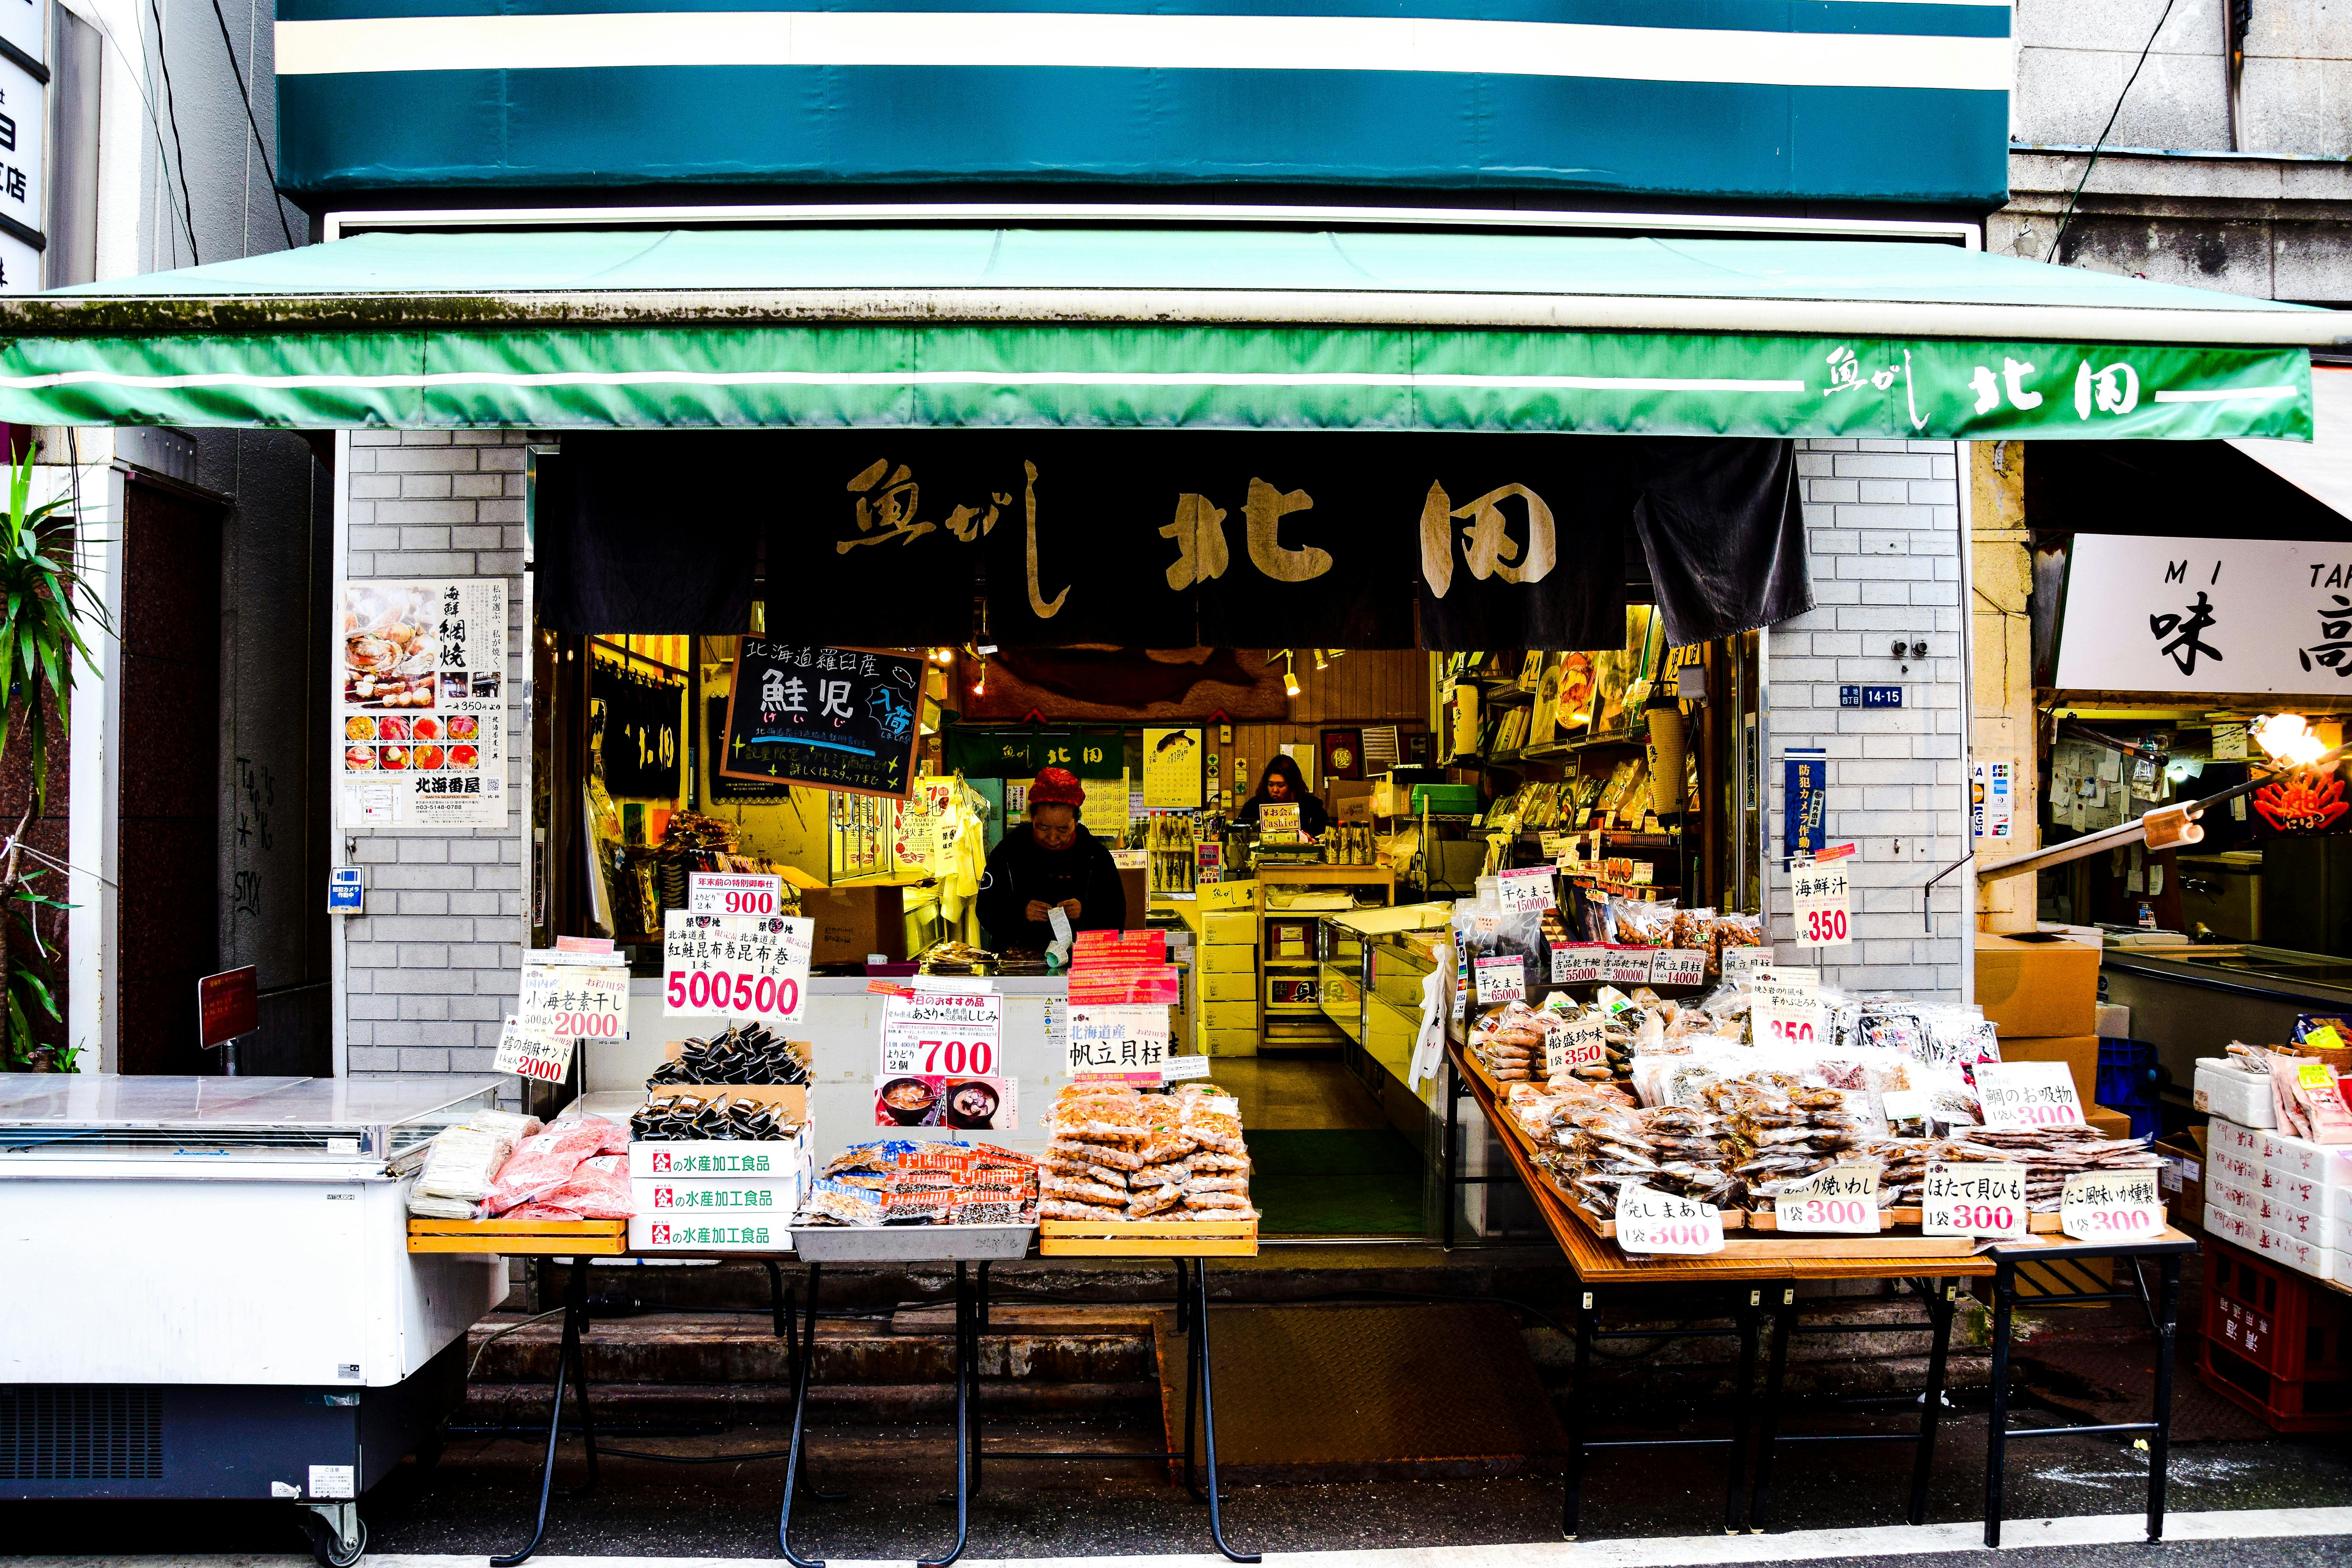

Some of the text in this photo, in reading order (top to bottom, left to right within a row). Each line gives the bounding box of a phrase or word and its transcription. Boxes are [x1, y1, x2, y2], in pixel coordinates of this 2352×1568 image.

[1824, 346, 2139, 429] 魚がし 北田
[836, 457, 1555, 618] 魚がし 北田
[439, 586, 466, 668] 海鮮網焼
[492, 584, 501, 669] 私が選ぶ、 私が焼く。
[2149, 591, 2223, 676] 味
[746, 641, 880, 677] 北海道羅臼産
[760, 668, 853, 718] 鮭児
[1868, 691, 1899, 702] 14-15
[872, 689, 913, 734] 入荷
[1047, 747, 1102, 764] 北田
[789, 763, 879, 785] 詳しくはスタッフまで
[416, 777, 481, 793] 北海番屋
[1263, 818, 1298, 828] Cashier
[698, 878, 774, 888] 年末前の特別御奉仕
[1795, 876, 1847, 897] 海鮮汁
[1503, 886, 1551, 901] 干なまこ
[668, 929, 707, 940] 北海道産
[740, 933, 810, 949] 北海道産 限定品
[1797, 929, 1809, 939] 1袋
[668, 941, 735, 959] 紅鮭昆布巻
[738, 944, 789, 965] 昆布巻
[691, 960, 712, 970] 1本
[759, 965, 780, 976] 1本
[1555, 958, 1601, 969] 吉品乾干鮑
[1604, 960, 1648, 969] 吉品乾干鮑
[1655, 960, 1702, 973] 帆立貝柱
[667, 971, 731, 1008] 500
[1479, 978, 1523, 990] 干なまこ
[1754, 985, 1804, 996] 焼き岩のり風味
[527, 990, 622, 1012] 小海老素干し
[906, 996, 984, 1007] 本日のおすすめ品
[1772, 996, 1816, 1007] 芽かぶとろろ
[969, 1010, 999, 1023] しじみ
[1069, 1024, 1126, 1040] 北海道産
[1548, 1027, 1604, 1050] 船盛珍味
[502, 1035, 570, 1061] 鱈の胡麻サンド
[887, 1050, 914, 1059] よりどり
[1069, 1040, 1163, 1067] 帆立貝柱
[890, 1060, 908, 1070] 2個
[1550, 1055, 1562, 1066] 1袋
[1985, 1085, 2072, 1106] 鯛のお吸物
[654, 1154, 770, 1172] 八丸 の水産加工食品
[655, 1189, 772, 1207] 八丸 の水産加工食品
[1928, 1178, 2020, 1201] ほたて貝ひも
[2064, 1183, 2155, 1206] たこ風味いか燻製
[1622, 1198, 1713, 1218] 焼しまあじ
[1782, 1207, 1802, 1221] 1袋
[1927, 1211, 1949, 1226] 1袋
[2069, 1219, 2089, 1232] 1袋
[653, 1225, 769, 1243] 八丸 の水産加工食品
[1626, 1222, 1710, 1246] 1袋 300
